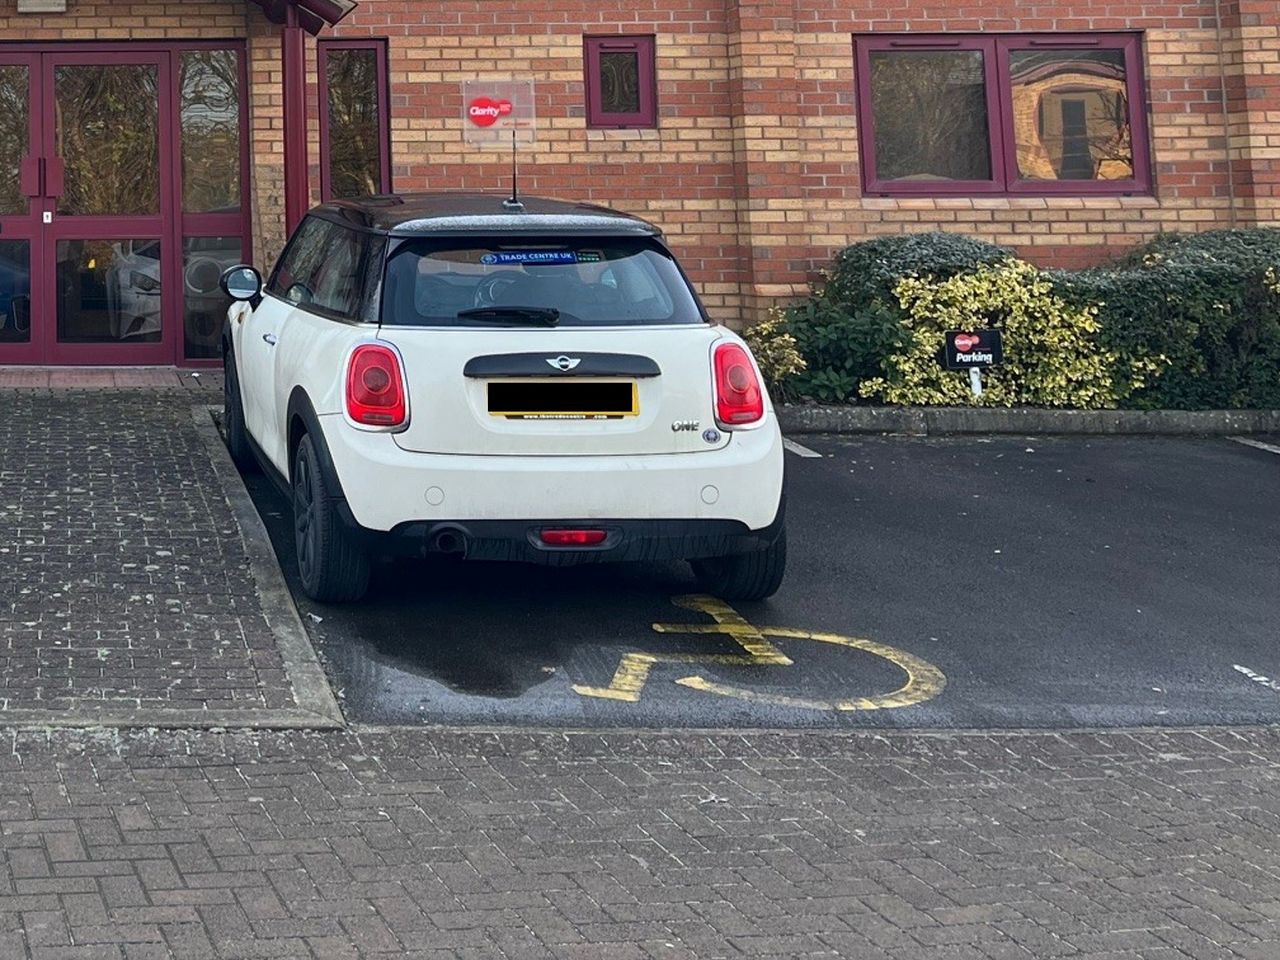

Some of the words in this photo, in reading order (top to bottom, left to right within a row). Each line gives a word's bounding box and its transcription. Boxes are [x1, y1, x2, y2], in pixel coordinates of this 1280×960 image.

[500, 253, 527, 261] TRADE
[528, 252, 559, 260] CENTRE
[956, 351, 993, 364] Parking
[671, 420, 700, 433] ONE
